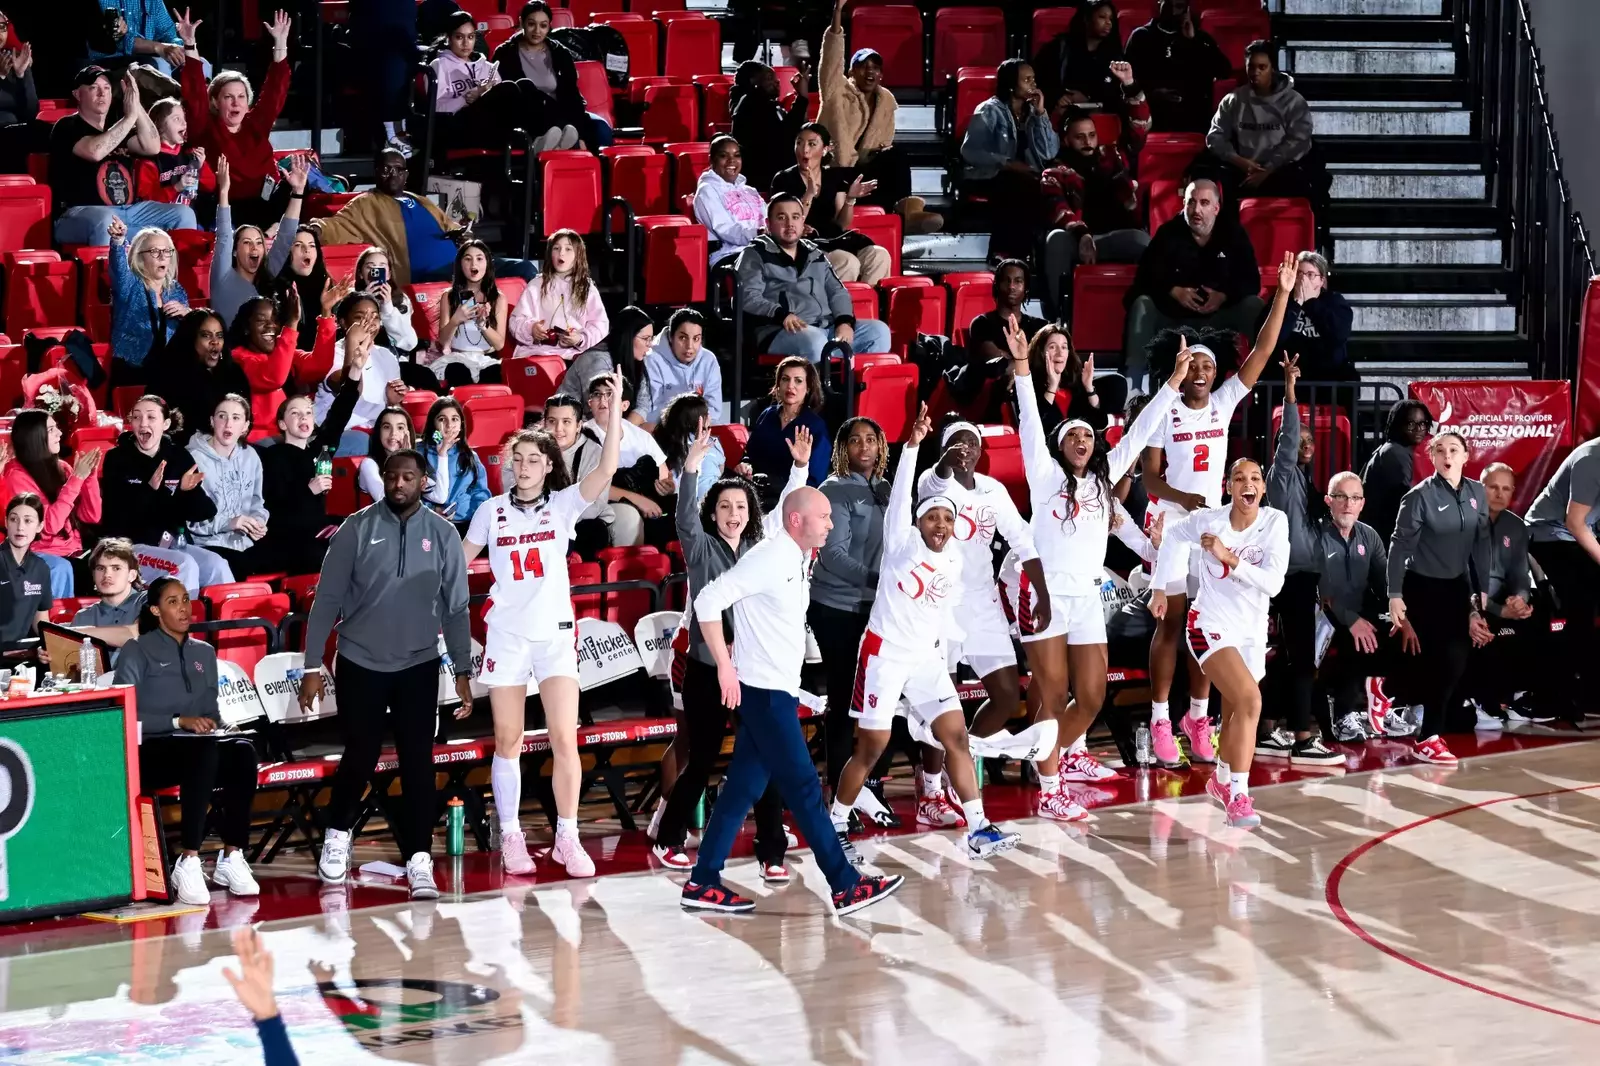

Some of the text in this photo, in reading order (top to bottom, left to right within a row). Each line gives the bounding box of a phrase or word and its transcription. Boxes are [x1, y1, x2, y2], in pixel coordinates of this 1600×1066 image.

[1468, 414, 1553, 422] OFFICIAL PT PROVIDER
[1173, 428, 1224, 442] RED STORM
[1472, 439, 1506, 447] THERAPY
[1193, 444, 1209, 472] 2
[496, 530, 555, 547] RED STORM
[510, 547, 544, 581] 14
[596, 632, 632, 655] tickets
[608, 646, 636, 661] center
[1107, 672, 1125, 681] TORM
[264, 679, 292, 696] event
[649, 726, 664, 734] RED
[586, 731, 627, 744] RED STORM
[434, 750, 476, 763] RED STORM
[269, 768, 315, 781] RED STORM
